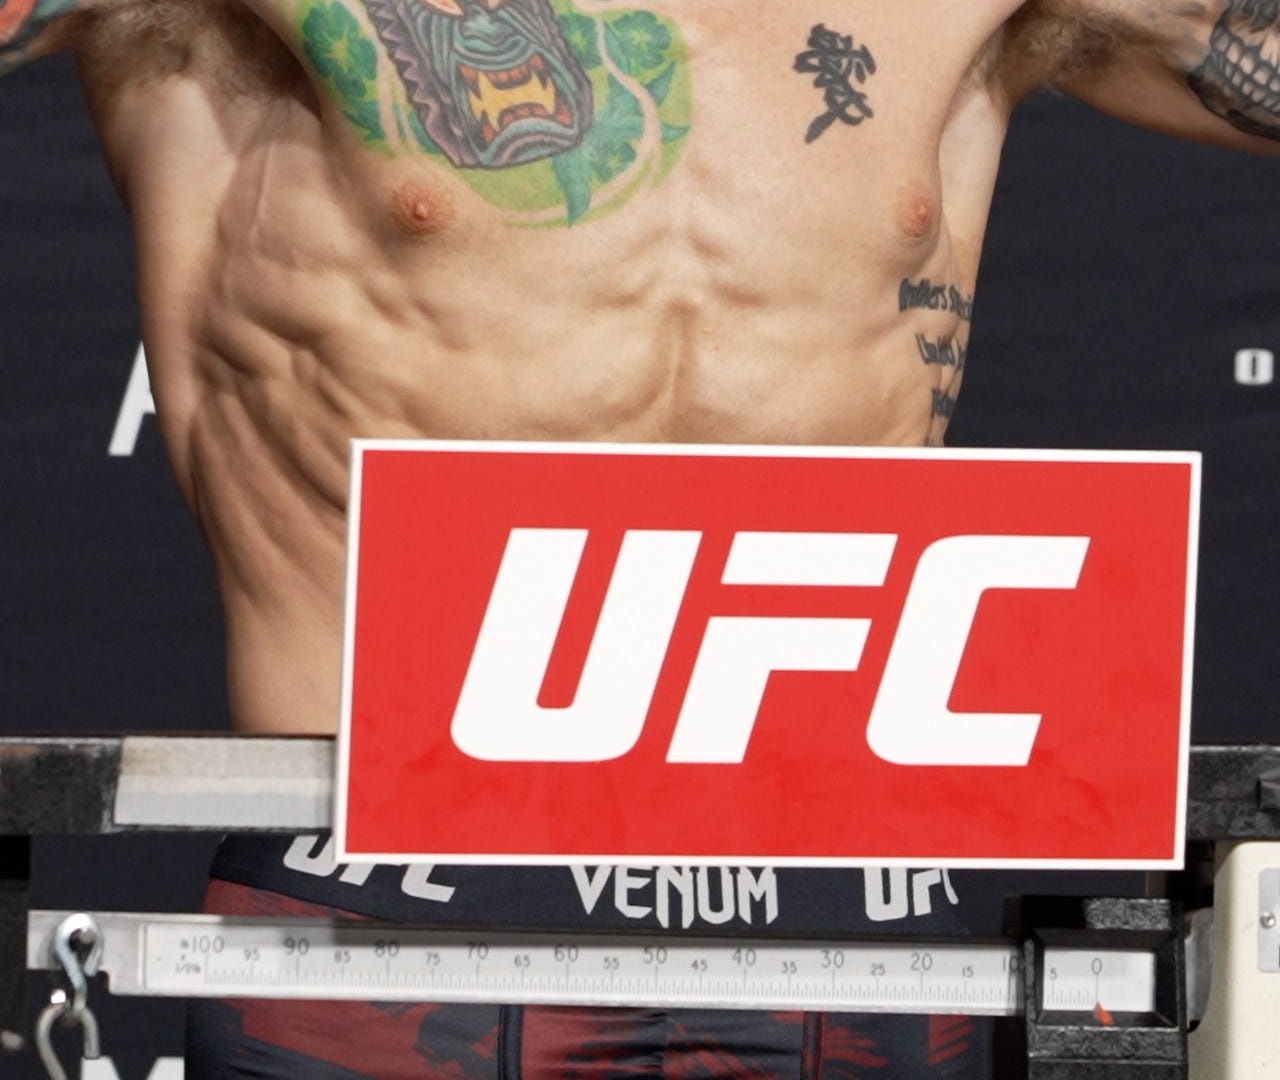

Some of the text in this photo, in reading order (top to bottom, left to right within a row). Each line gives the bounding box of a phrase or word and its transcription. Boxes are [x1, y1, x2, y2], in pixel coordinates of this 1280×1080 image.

[450, 527, 1091, 767] UFC
[569, 866, 779, 929] VENOM
[190, 935, 225, 955] 100
[282, 937, 310, 957] 90
[374, 939, 400, 958] 80
[466, 942, 489, 961] 70
[553, 944, 579, 964] 60
[642, 946, 668, 965] 50
[731, 948, 757, 967] 40
[821, 950, 845, 969] 30
[910, 952, 933, 971] 20
[1091, 957, 1103, 975] 0
[869, 963, 886, 976] 25
[1049, 968, 1058, 979] 5
